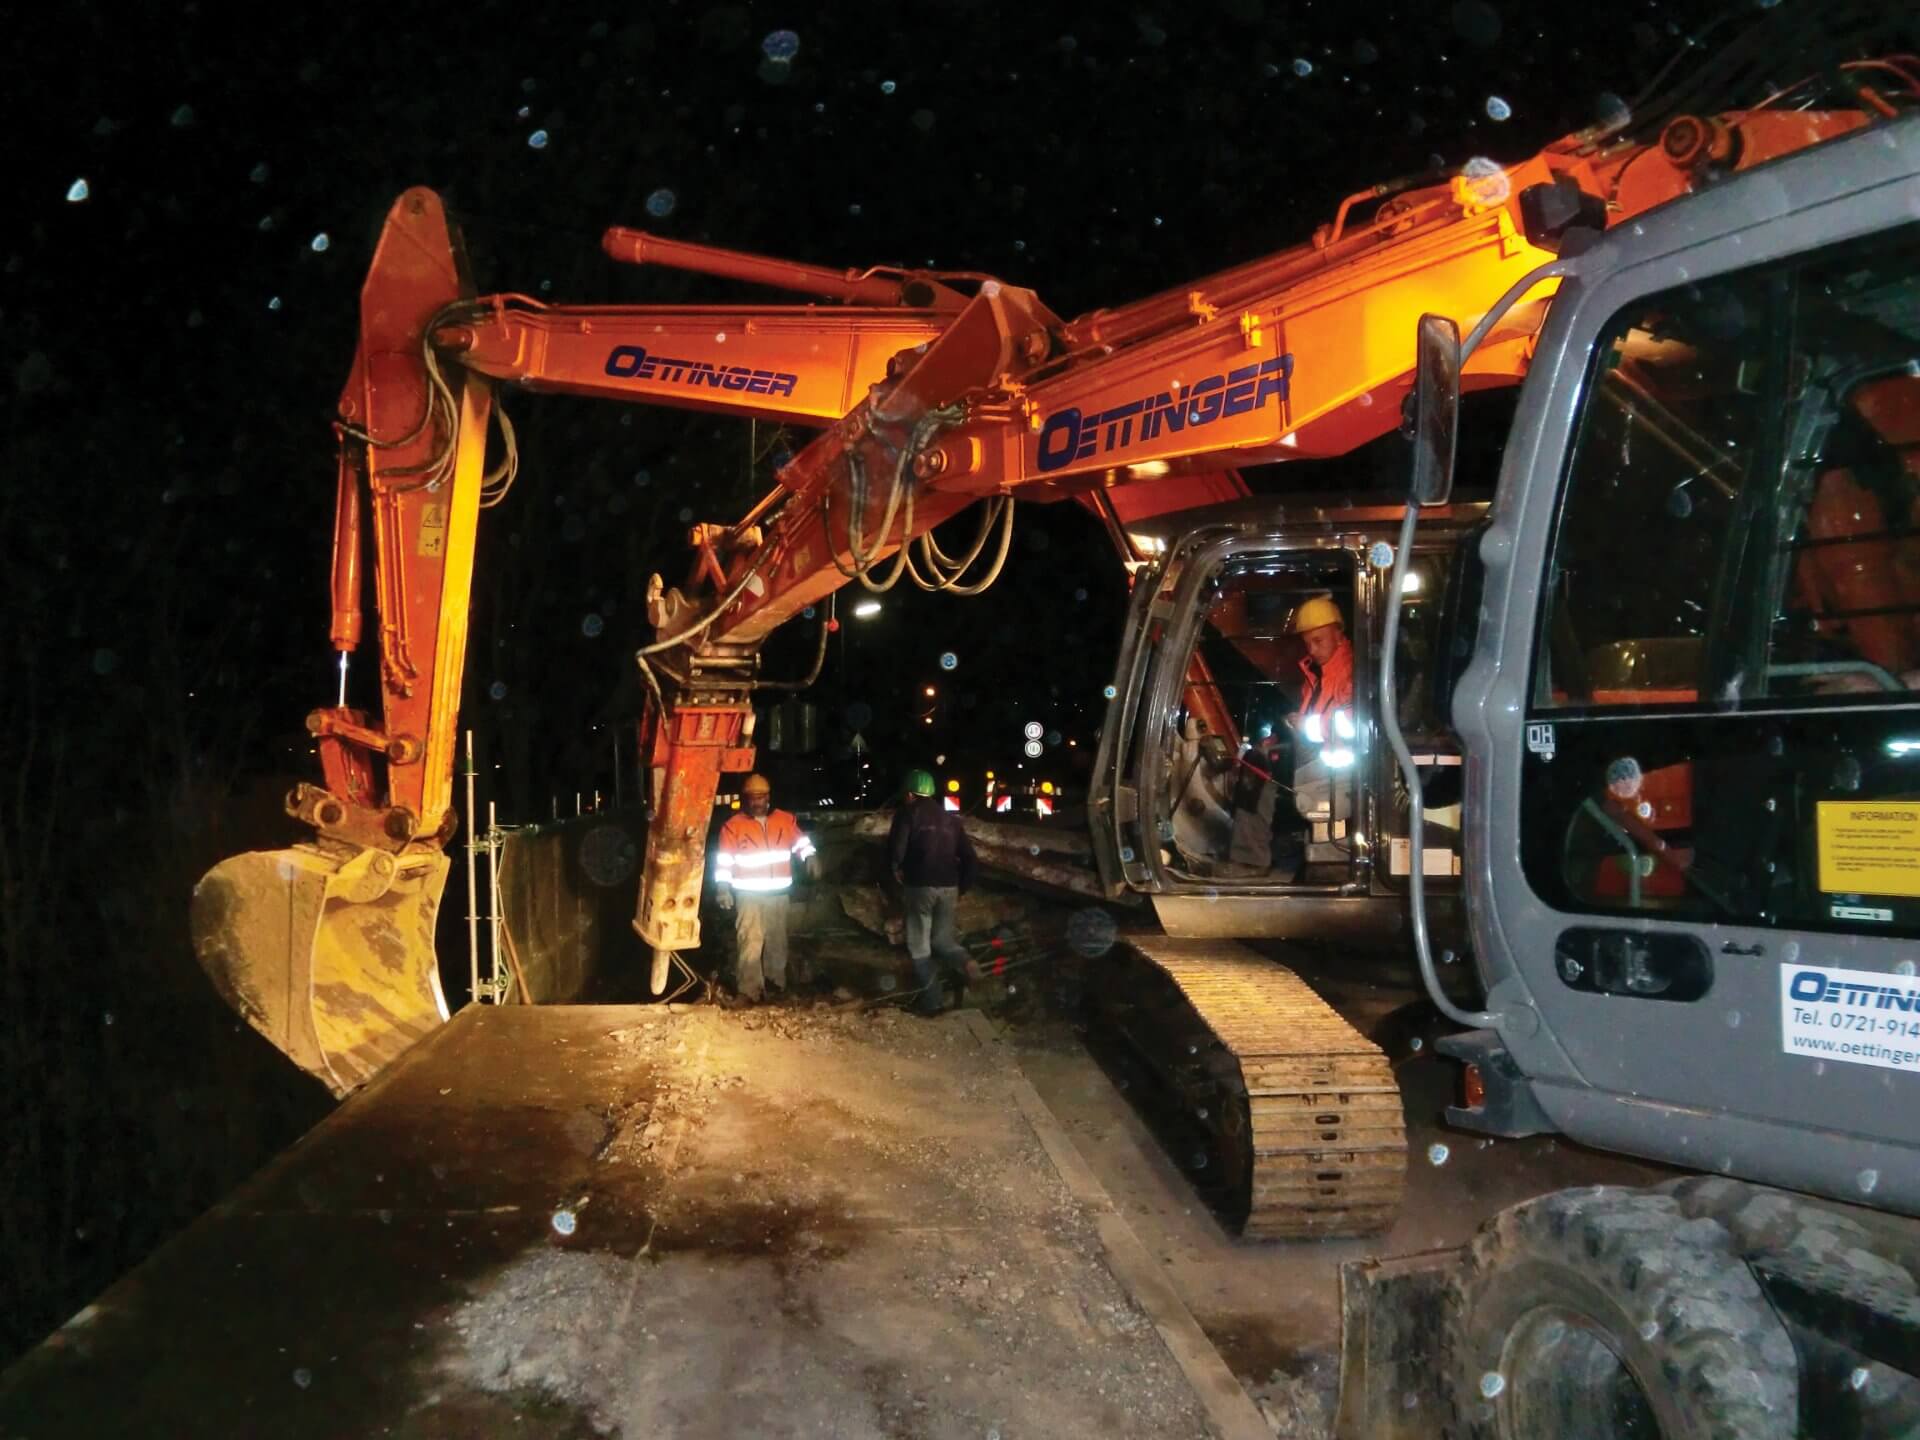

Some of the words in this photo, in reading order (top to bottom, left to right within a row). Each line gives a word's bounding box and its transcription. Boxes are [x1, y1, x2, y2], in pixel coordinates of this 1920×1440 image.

[605, 345, 798, 397] OETTINGER
[1037, 353, 1294, 472] OETTINGER
[1851, 811, 1918, 821] INFORMATION
[1790, 971, 1920, 1012] OETTIN
[1793, 1007, 1822, 1026] Tel.
[1830, 1012, 1920, 1039] 0721-914
